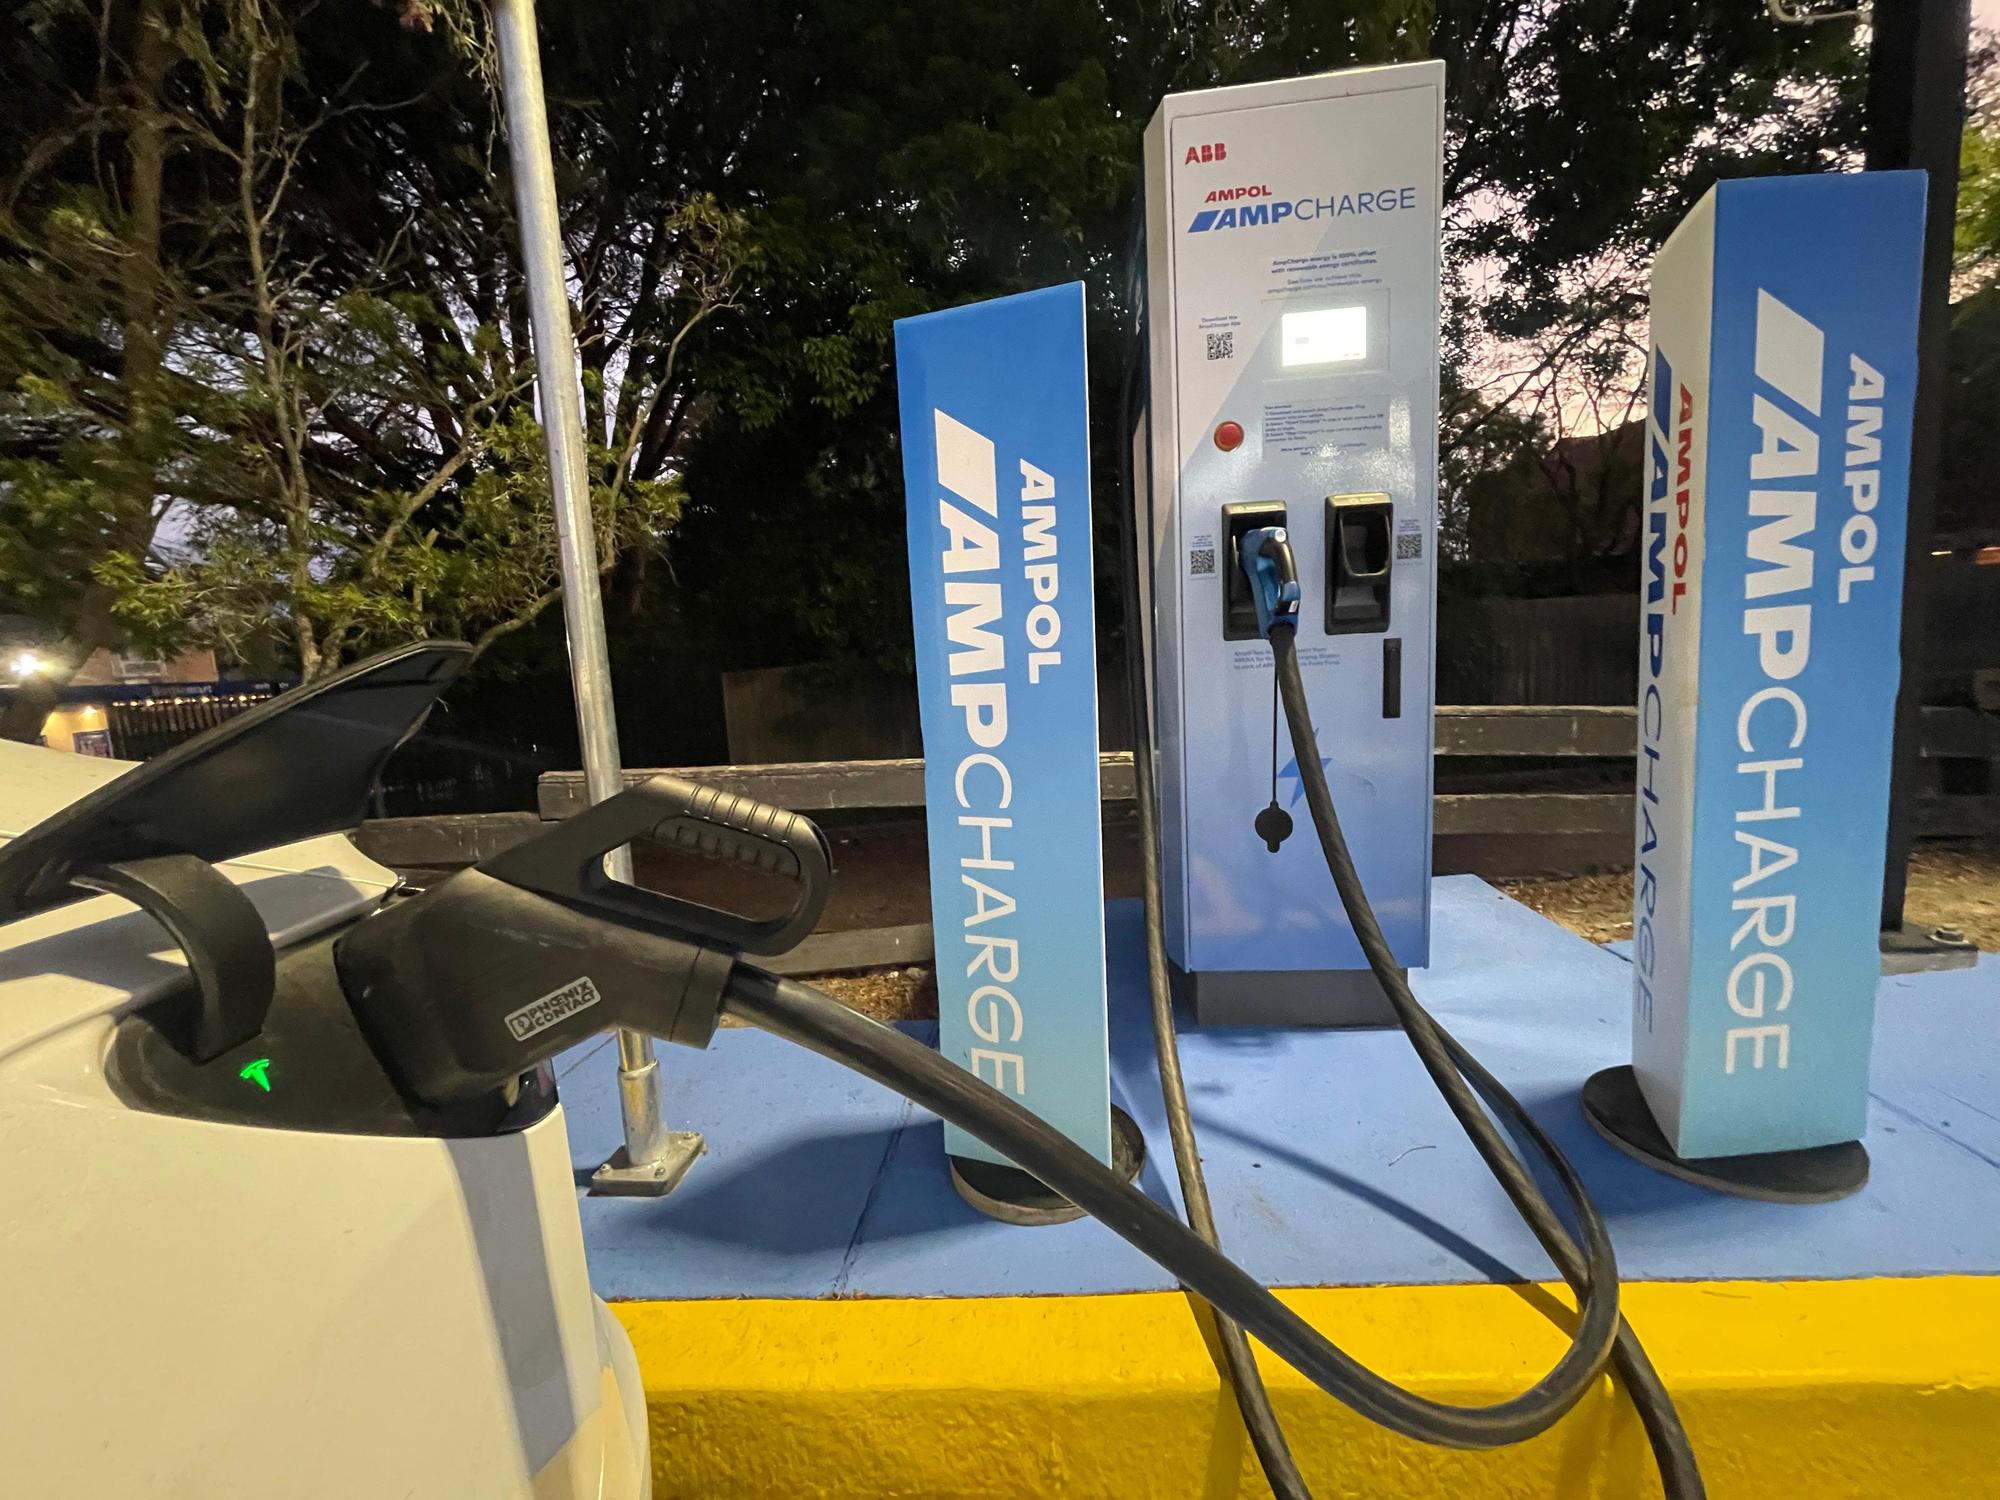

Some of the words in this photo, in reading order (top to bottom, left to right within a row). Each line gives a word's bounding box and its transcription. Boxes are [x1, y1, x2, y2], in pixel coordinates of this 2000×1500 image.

[1185, 143, 1227, 165] ABB
[1204, 185, 1272, 203] AMPOL
[1214, 187, 1416, 230] AMPCHARGE
[1019, 458, 1062, 684] AMPOL
[1672, 382, 1693, 615] AMPOL
[1838, 353, 1885, 603] AMPOL
[940, 499, 1025, 1095] AMPCHARGE
[1634, 428, 1669, 1034] AMPCHARGE
[1725, 393, 1820, 1074] AMPCHARGE
[535, 990, 595, 1027] CONTACT
